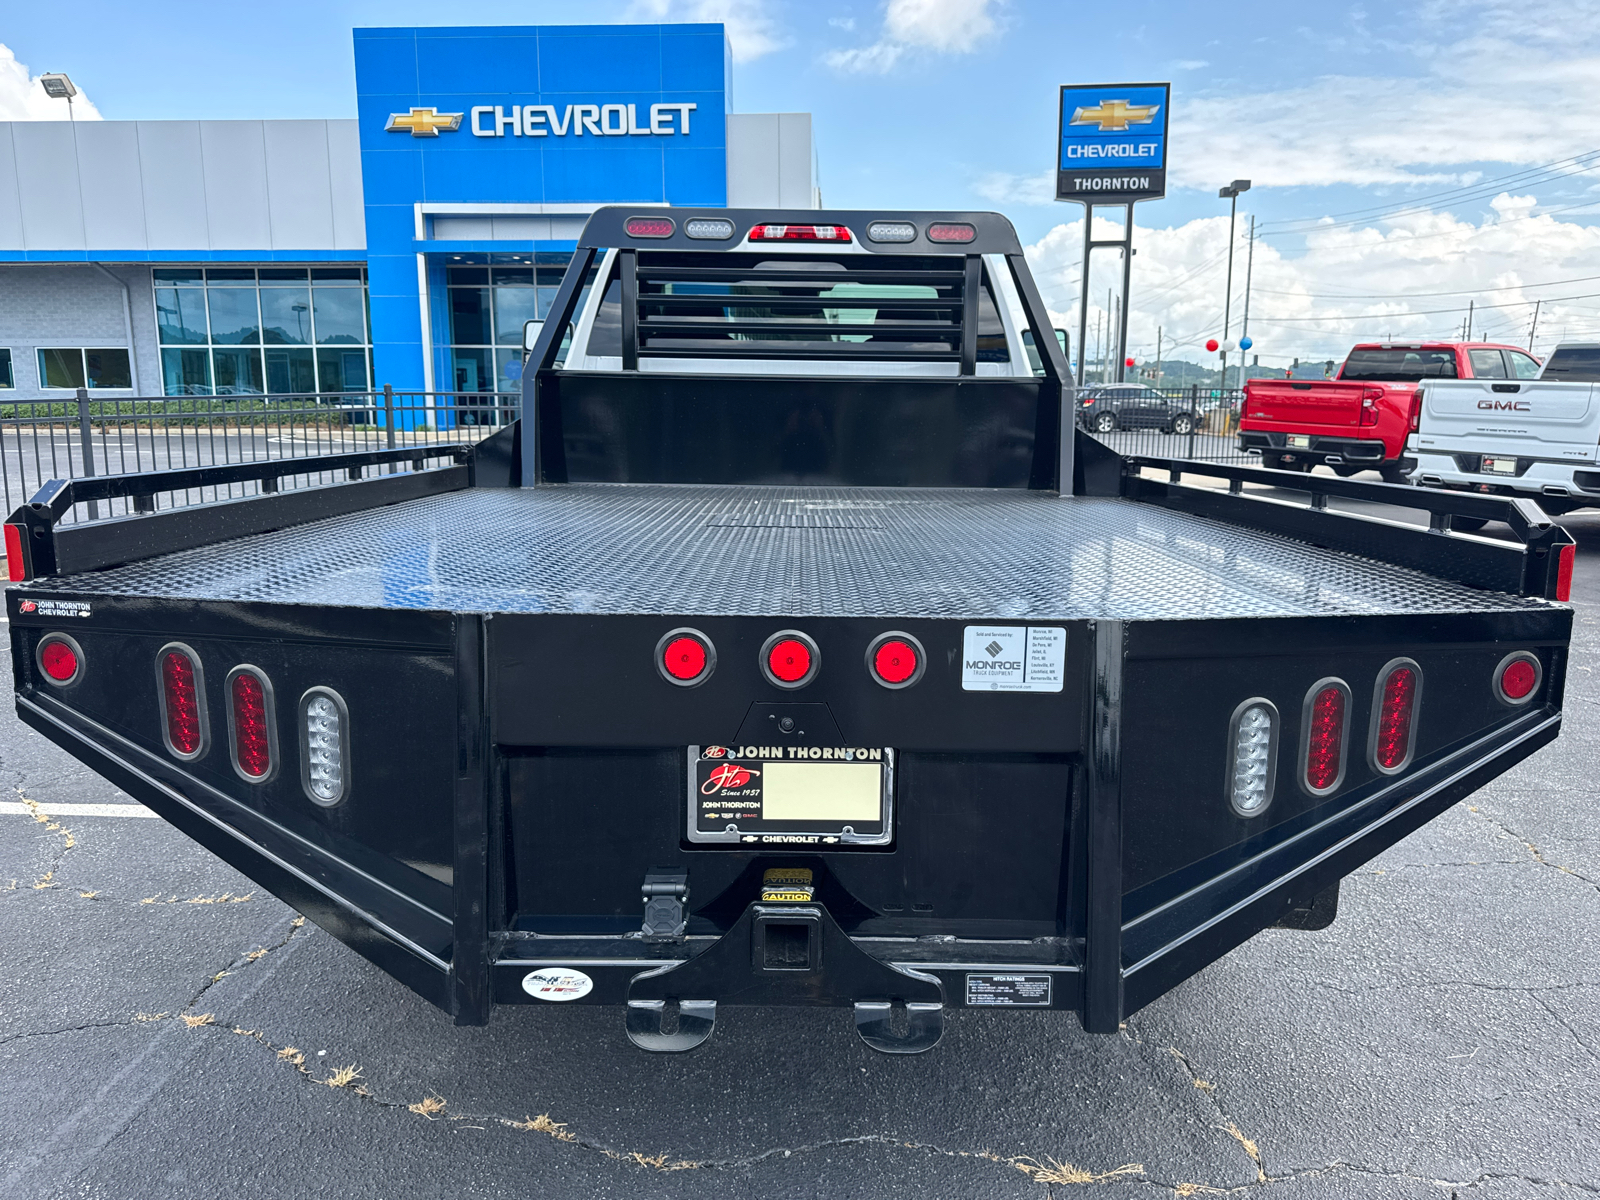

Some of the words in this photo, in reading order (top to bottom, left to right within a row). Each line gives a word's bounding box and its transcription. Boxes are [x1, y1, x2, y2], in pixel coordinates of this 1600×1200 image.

[471, 103, 697, 137] CHEVROLET
[1067, 144, 1158, 158] CHEVROLET
[1074, 177, 1149, 190] THORNTON
[1477, 400, 1531, 412] GMC
[38, 601, 54, 609] JOHN
[55, 601, 90, 610] THORNTON
[38, 608, 78, 616] CHEVROLET
[966, 660, 1021, 670] MONROE
[736, 746, 783, 758] JOHN
[787, 747, 881, 760] THORNTON
[762, 835, 819, 843] CHEVROLET
[763, 893, 811, 901] CAUTION
